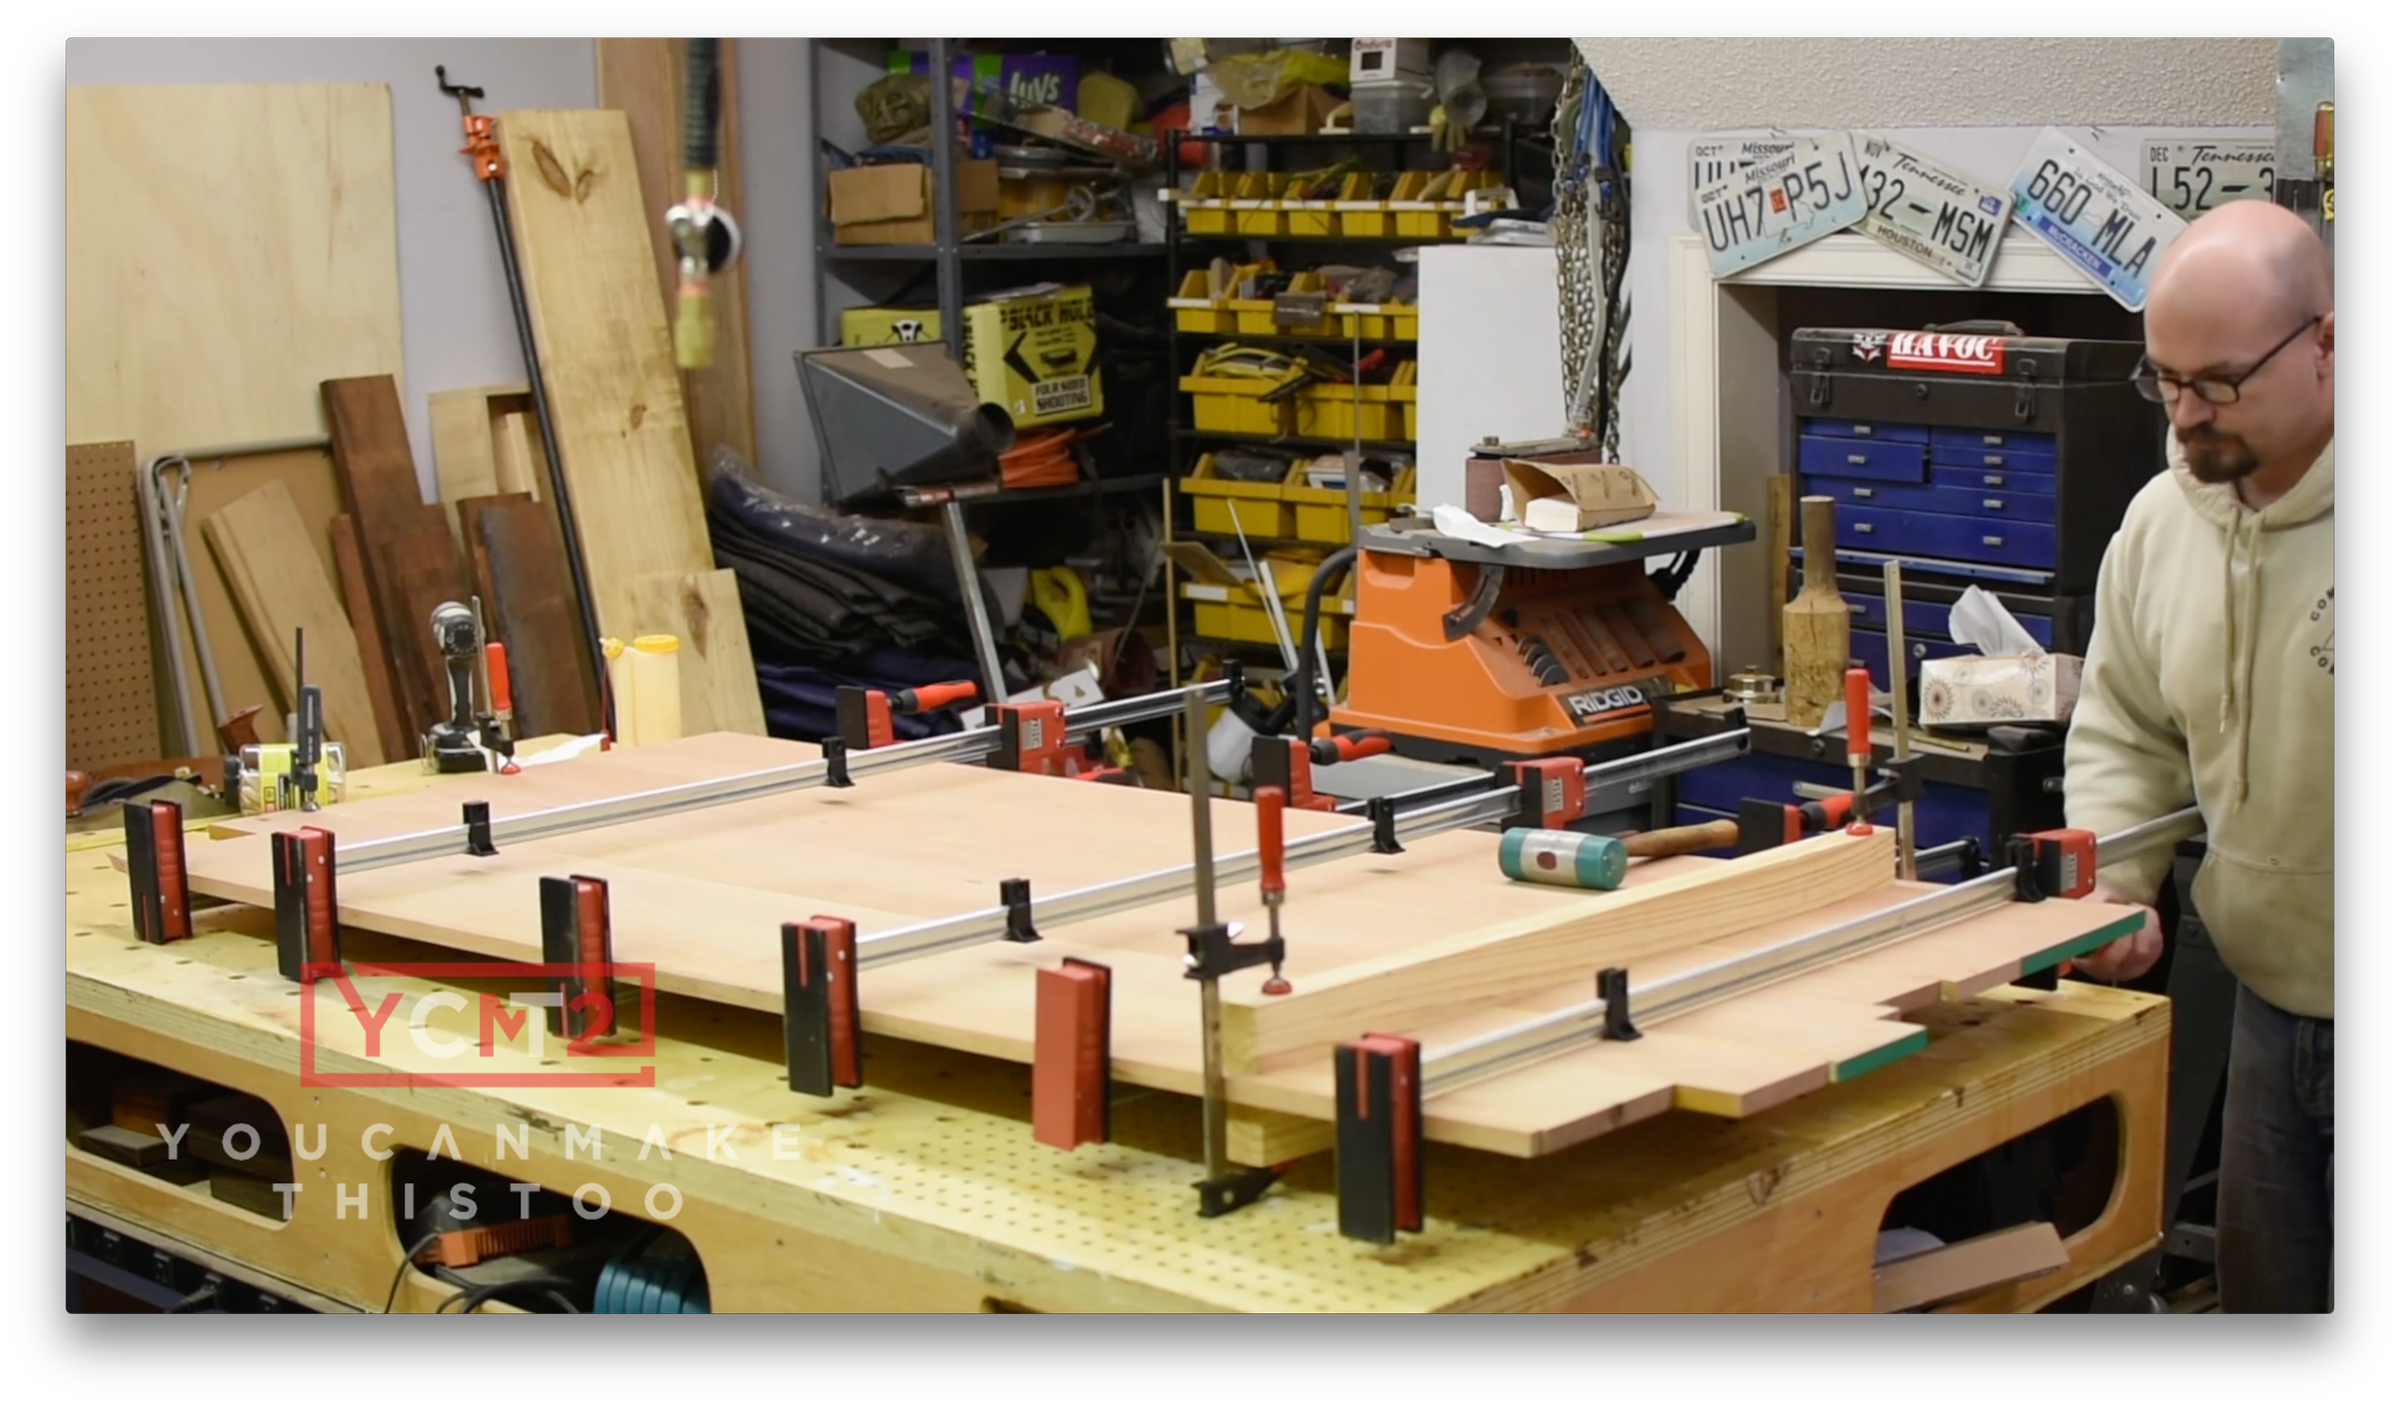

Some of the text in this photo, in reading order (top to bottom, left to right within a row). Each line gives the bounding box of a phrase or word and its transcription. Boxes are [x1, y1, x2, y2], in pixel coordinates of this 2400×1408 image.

[1745, 152, 1796, 184] Missouri
[2149, 146, 2169, 162] DEC
[2191, 145, 2275, 165] Tennesse
[1893, 152, 1966, 196] Tennessee
[1703, 186, 1764, 251] UH7
[1782, 151, 1852, 222] P5J
[1930, 200, 1995, 263] MSM
[2026, 158, 2157, 279] 660 MLA
[1876, 224, 1934, 258] HOUSTON
[1891, 332, 1999, 361] HAVOC
[1568, 685, 1644, 716] RIDGID
